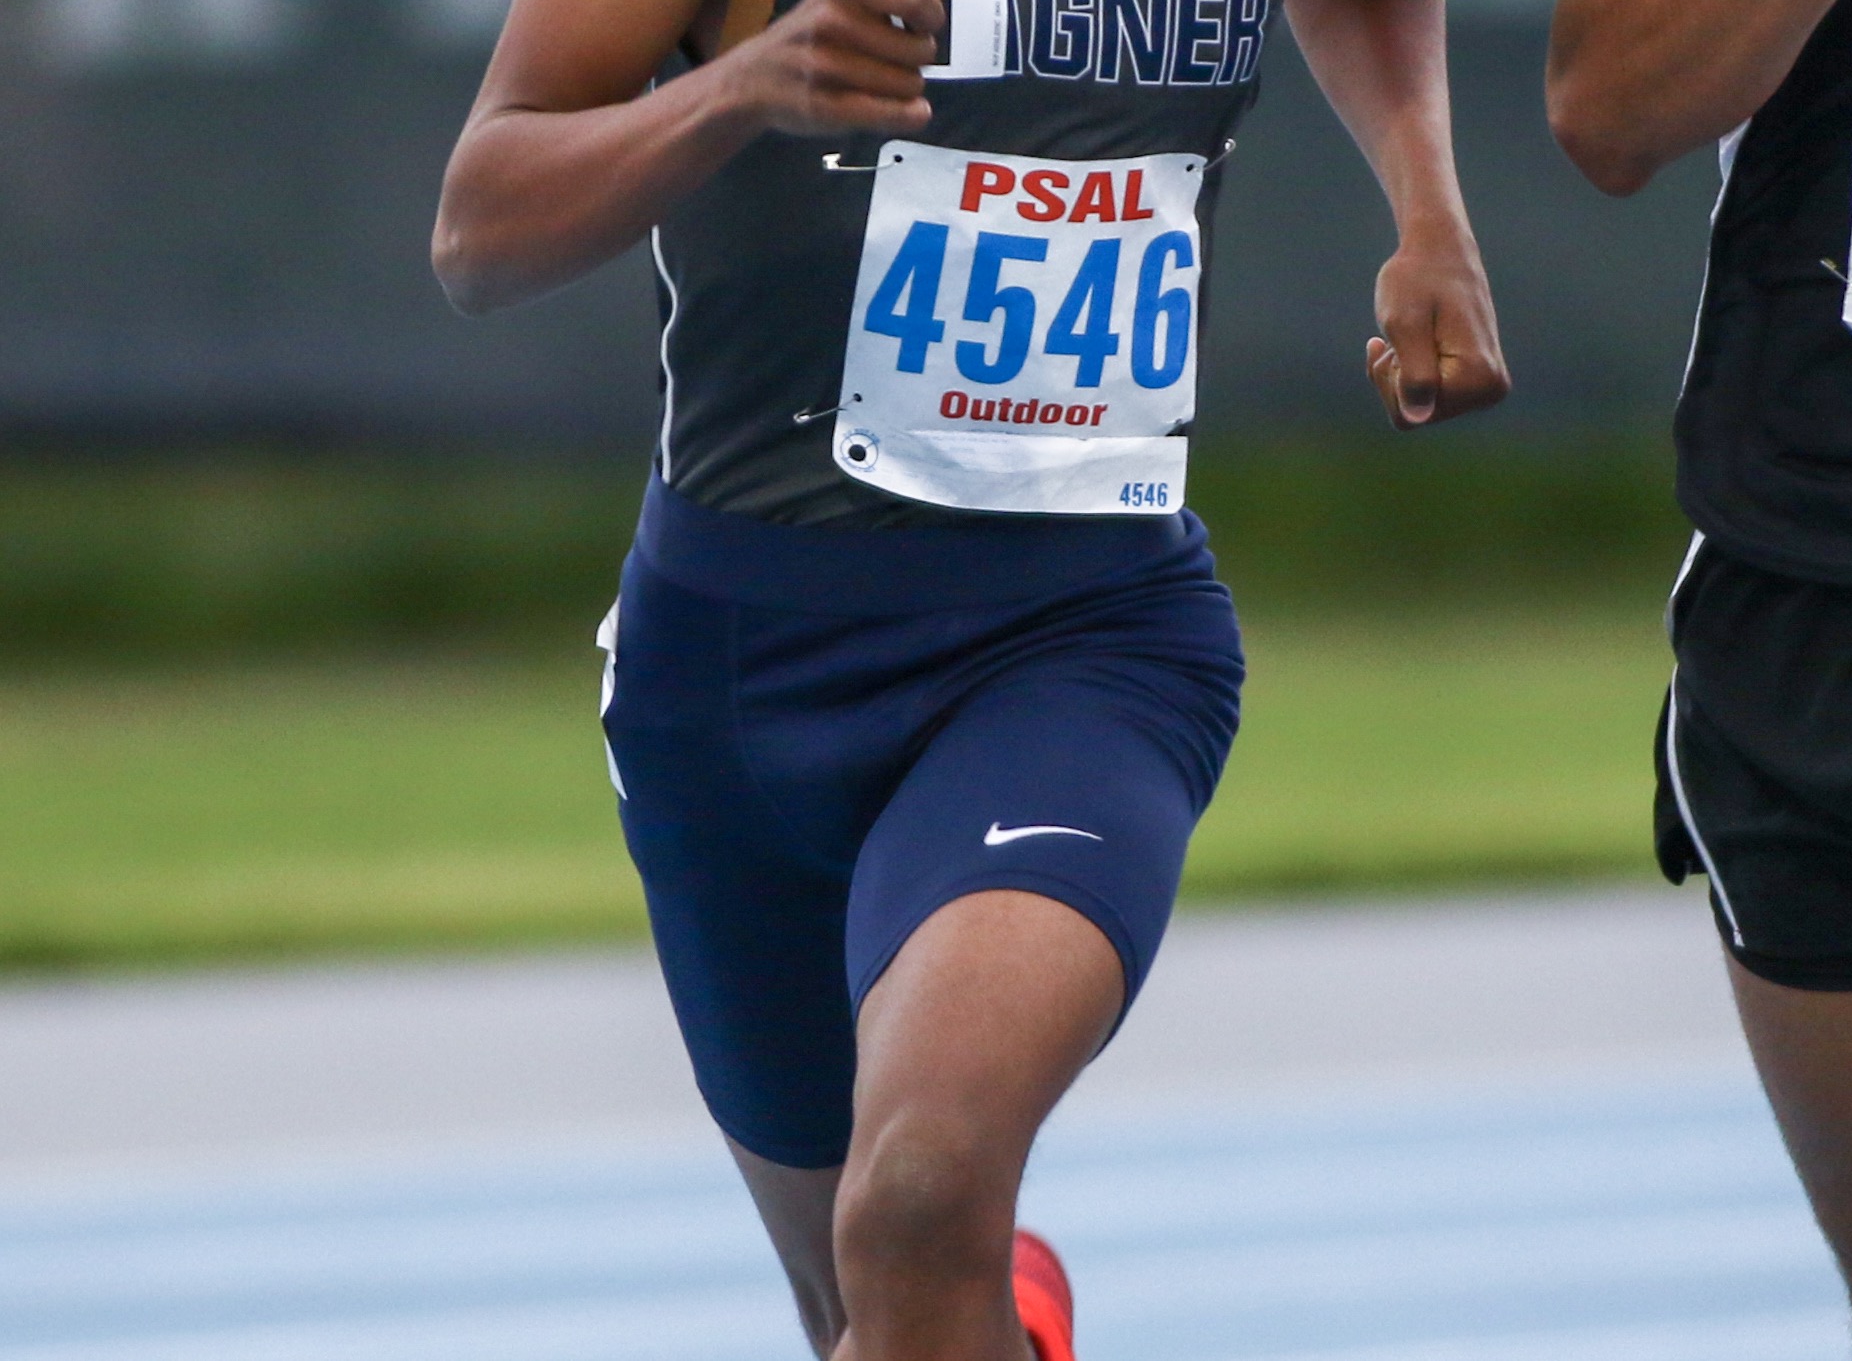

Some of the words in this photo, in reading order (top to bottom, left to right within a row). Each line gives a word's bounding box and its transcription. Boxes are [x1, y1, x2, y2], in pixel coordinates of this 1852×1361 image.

[958, 160, 1154, 224] PSAL
[863, 219, 1195, 391] 4546
[939, 390, 1109, 427] Outdoor
[1118, 482, 1169, 508] 4546
